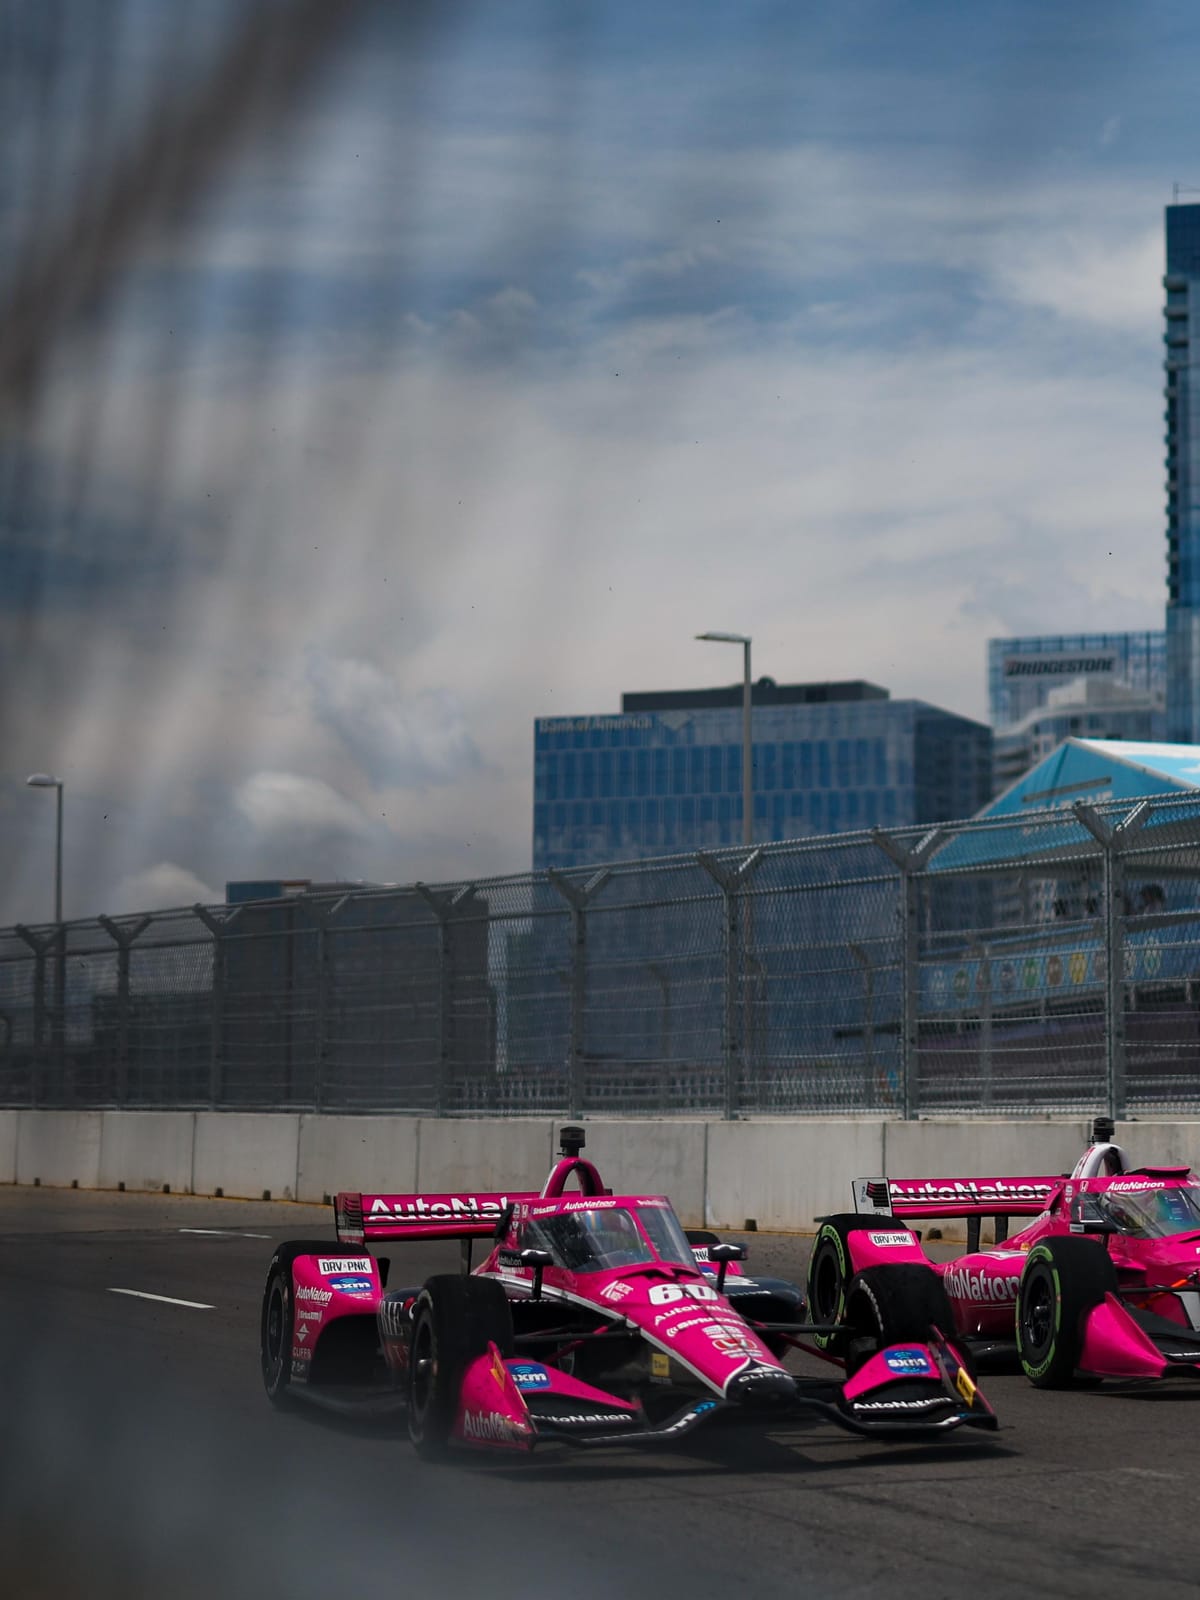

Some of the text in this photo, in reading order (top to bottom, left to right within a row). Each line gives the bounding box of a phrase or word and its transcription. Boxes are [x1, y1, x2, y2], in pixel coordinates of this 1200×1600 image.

[1006, 657, 1115, 676] BRIDGESTONE
[890, 1181, 1053, 1202] AutoNation
[1107, 1181, 1165, 1192] AutoNation
[563, 1200, 617, 1211] AutoNation
[874, 1234, 910, 1245] DRV PNK
[322, 1259, 369, 1273] DRV PNK
[296, 1285, 333, 1302] AutoNation
[648, 1283, 719, 1305] 60
